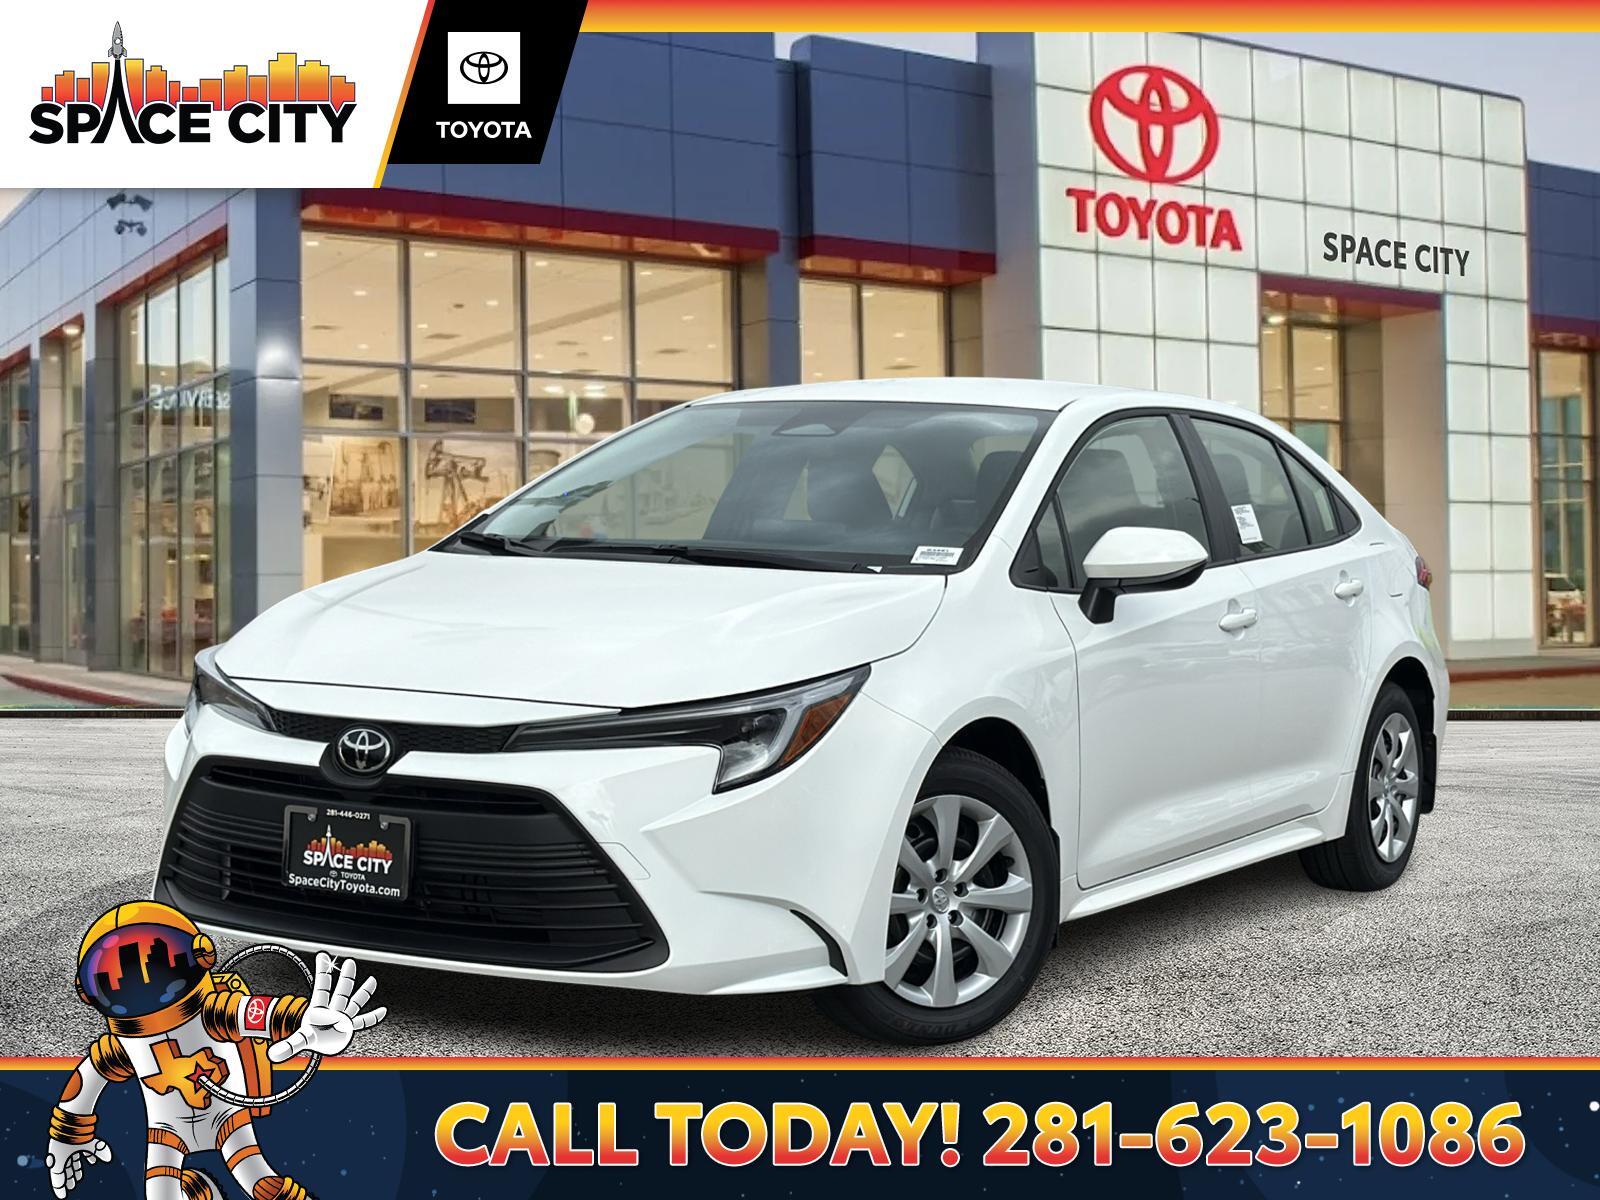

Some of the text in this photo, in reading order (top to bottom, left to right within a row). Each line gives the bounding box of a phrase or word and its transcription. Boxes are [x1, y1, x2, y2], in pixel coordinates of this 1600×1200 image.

[1065, 188, 1243, 251] TOYOTA
[1322, 232, 1470, 276] SPACE CITY
[303, 837, 392, 874] SPACE CITY
[288, 873, 400, 897] SpaceCityToyota.com
[340, 871, 366, 881] TOYOTA
